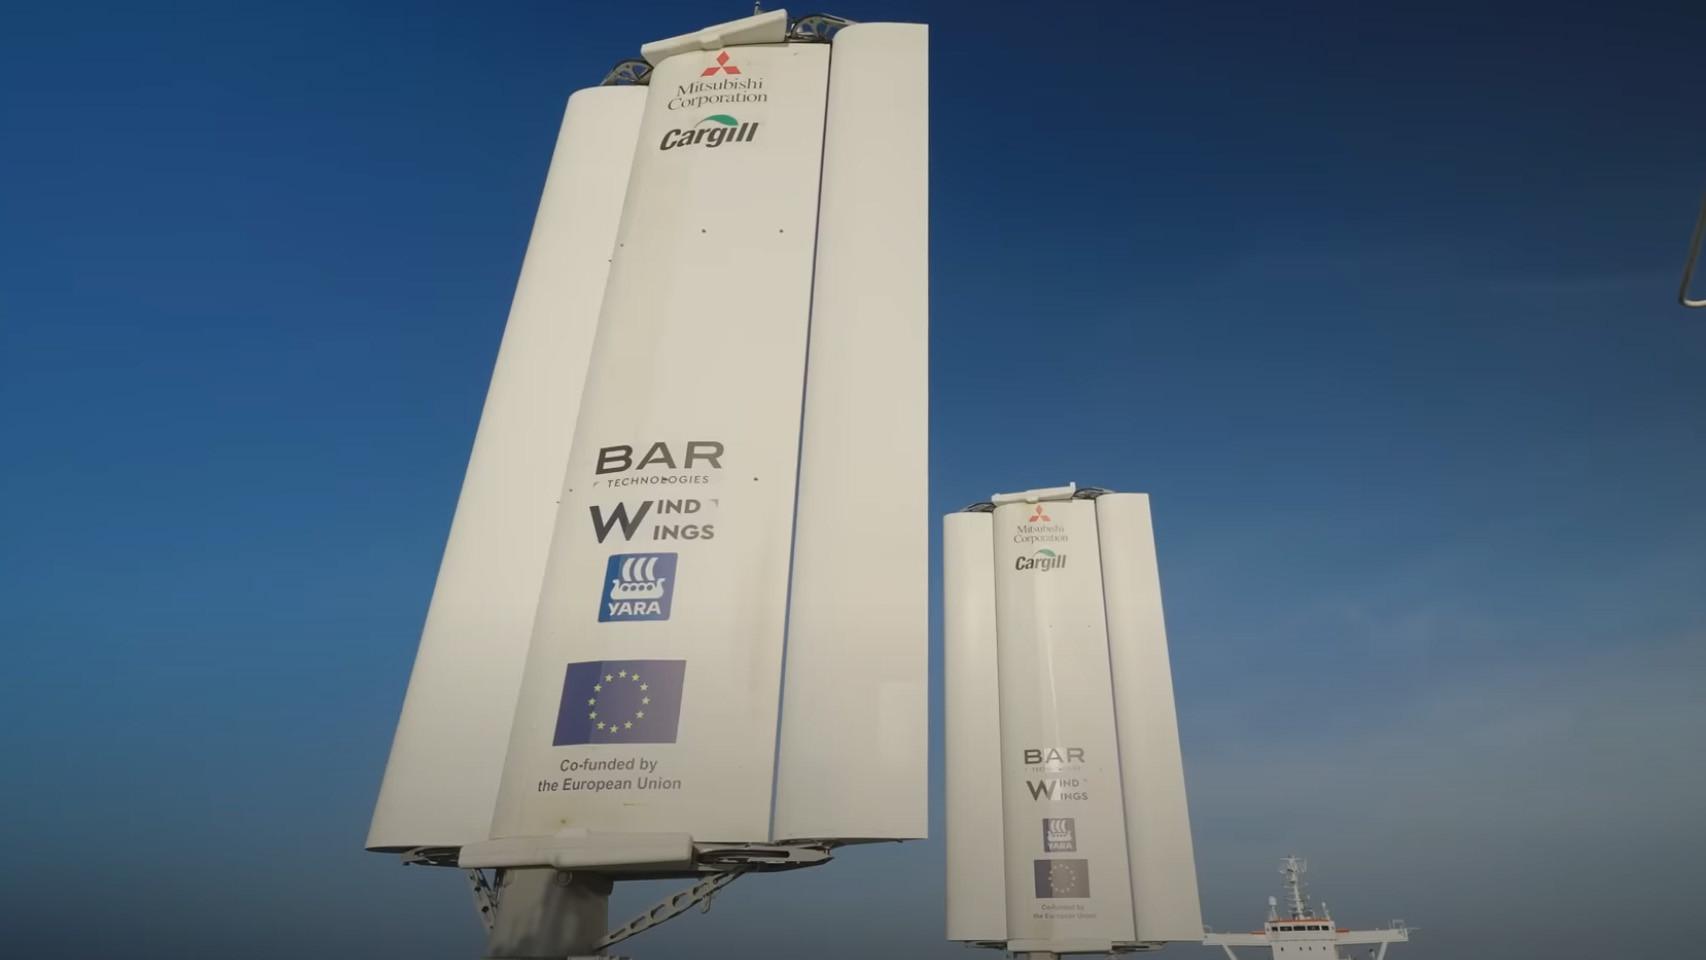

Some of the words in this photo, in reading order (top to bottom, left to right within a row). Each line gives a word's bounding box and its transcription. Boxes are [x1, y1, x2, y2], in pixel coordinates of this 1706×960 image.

[677, 78, 763, 96] Mitsubishi
[667, 91, 767, 110] Corporation
[660, 122, 759, 150] Cargill
[595, 441, 724, 475] BAR
[607, 475, 709, 488] TECHNOLOGIES
[1015, 554, 1066, 572] Cargill
[608, 601, 661, 616] YARA
[1024, 748, 1085, 764] BAR
[560, 758, 635, 772] Co-funded
[639, 757, 658, 773] by
[538, 780, 559, 792] the
[562, 778, 632, 792] European
[637, 777, 682, 790] Union
